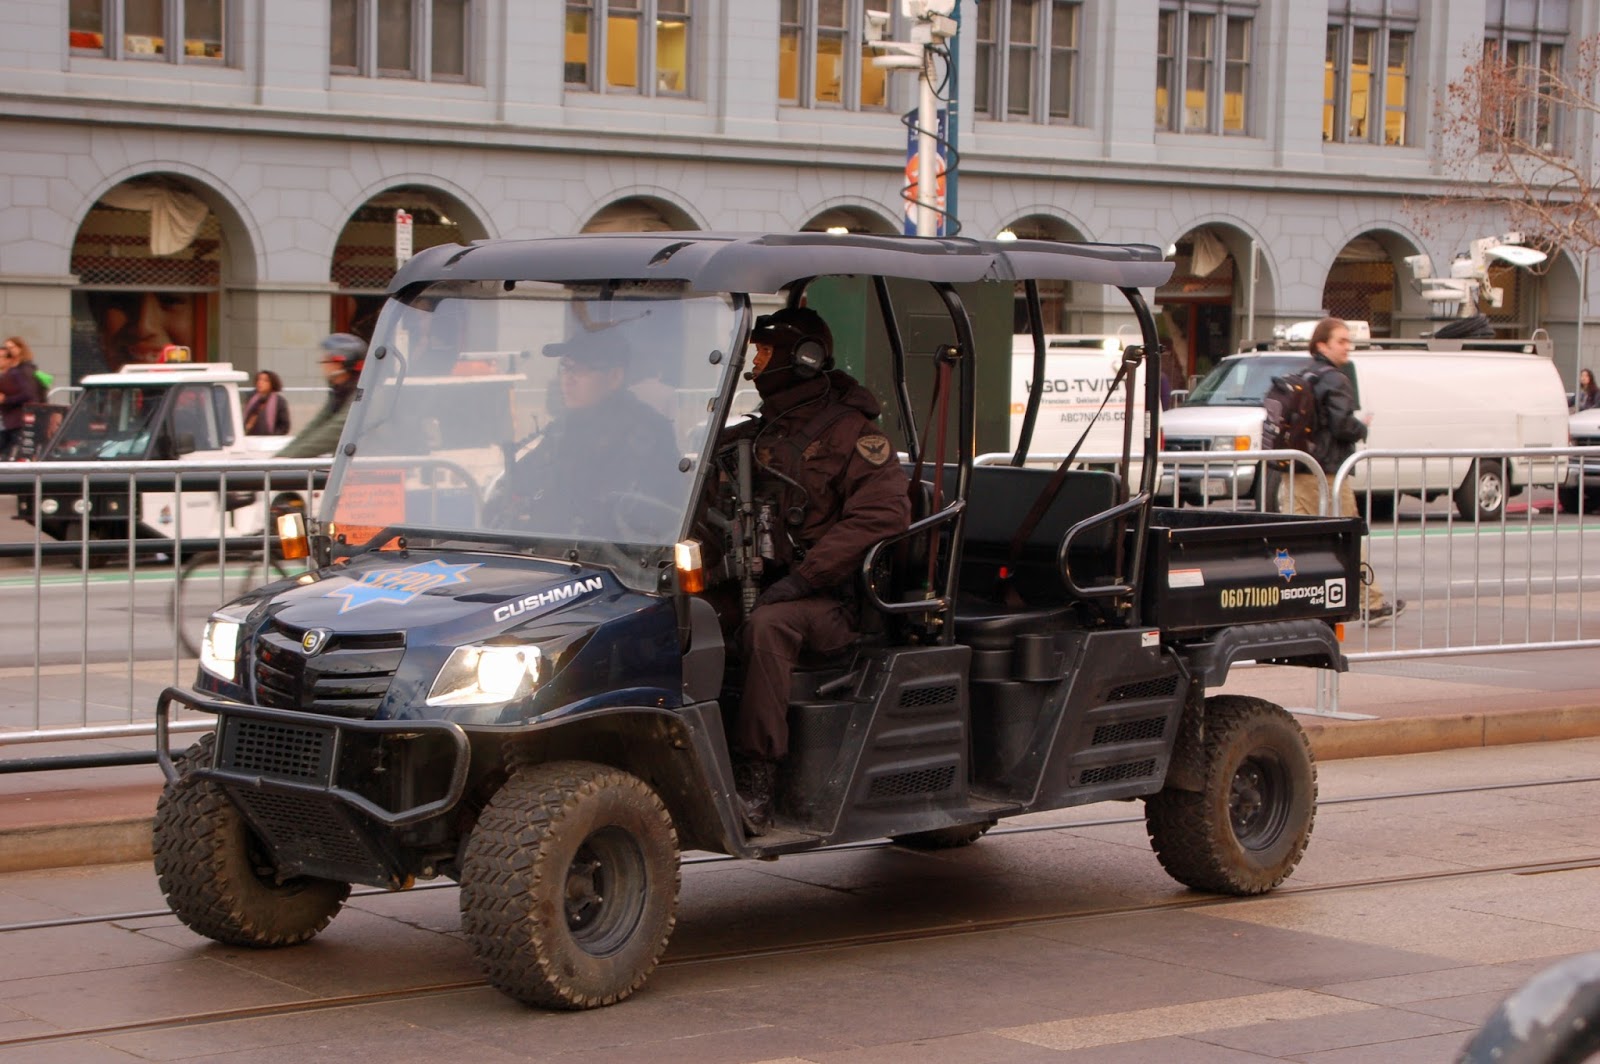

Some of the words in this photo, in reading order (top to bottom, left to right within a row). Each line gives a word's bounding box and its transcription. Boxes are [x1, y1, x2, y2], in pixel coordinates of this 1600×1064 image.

[1060, 411, 1134, 422] ABC7NEWS.CO
[493, 576, 603, 622] CUSHMAN
[1221, 586, 1280, 608] 060711010
